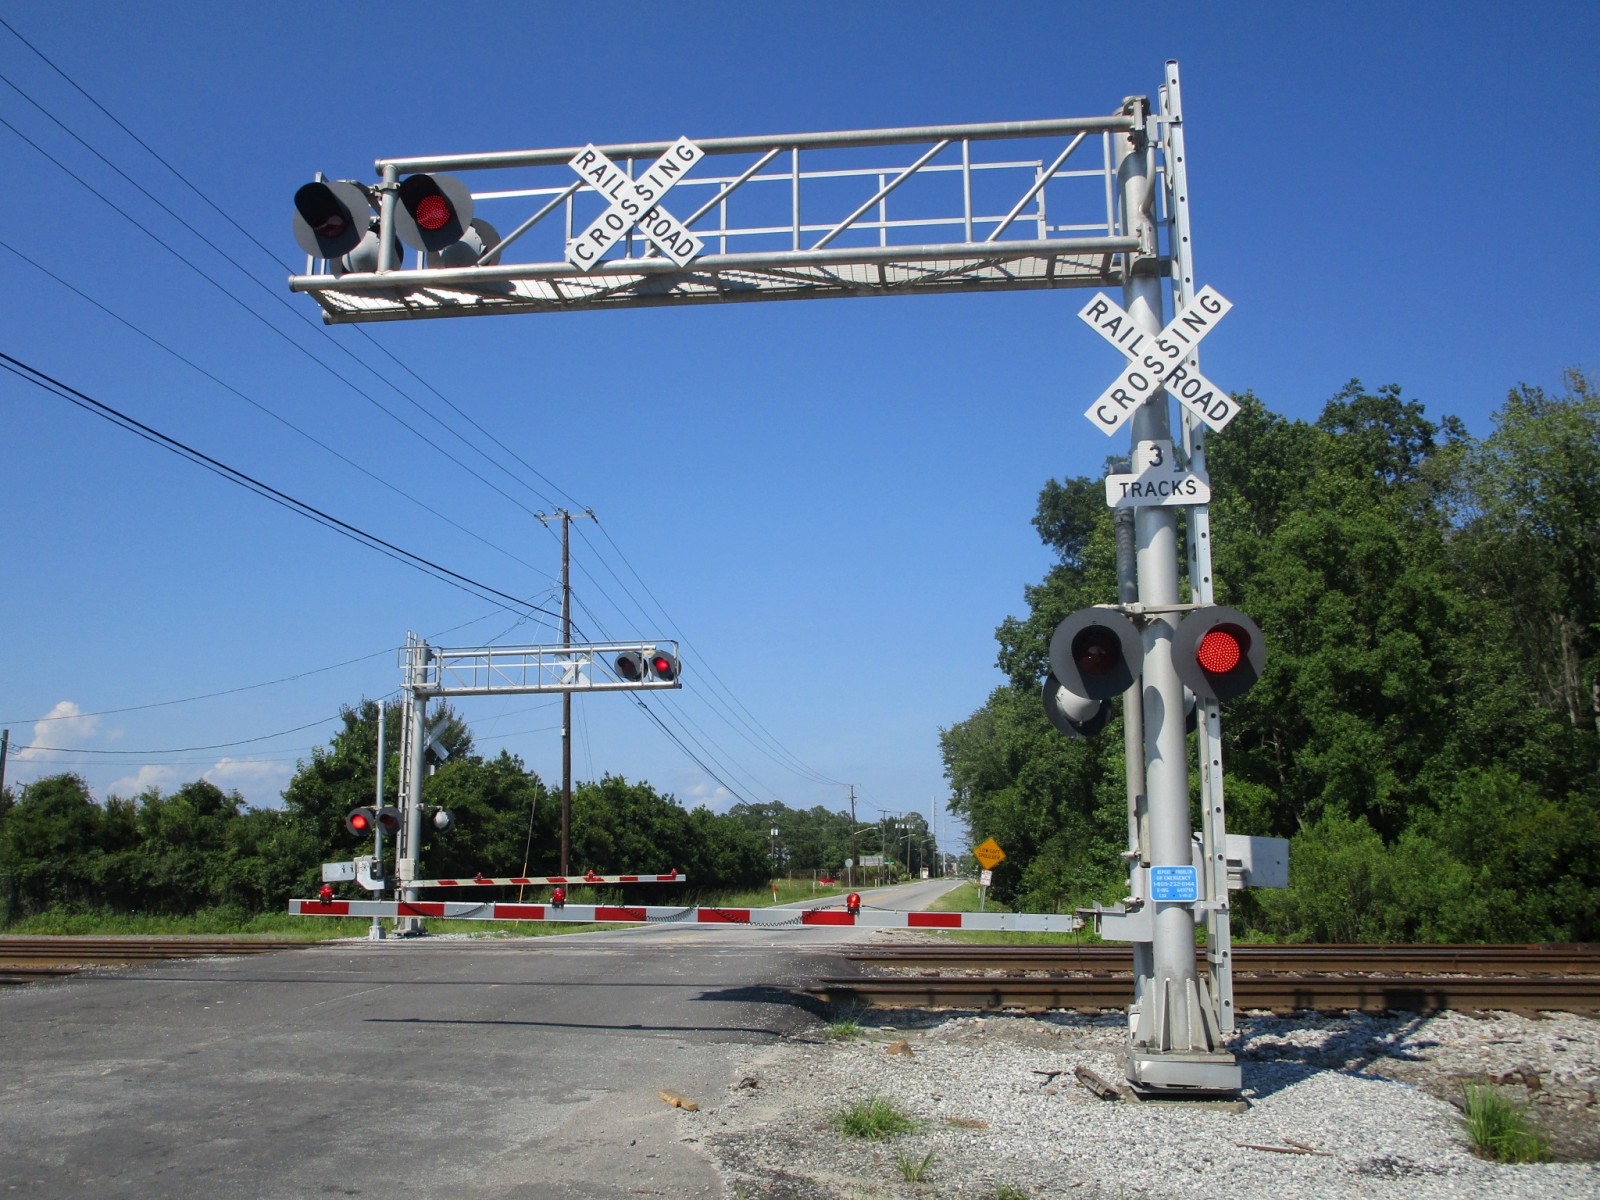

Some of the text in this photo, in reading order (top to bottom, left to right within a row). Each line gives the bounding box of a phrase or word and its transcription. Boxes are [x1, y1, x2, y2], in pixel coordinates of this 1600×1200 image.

[575, 145, 694, 260] CROSSING
[576, 150, 694, 257] RAIL ROAD
[1086, 300, 1229, 421] RAIL ROAD
[1096, 295, 1221, 425] CROSSING
[1119, 480, 1197, 498] TRACKS
[1149, 445, 1163, 467] 3
